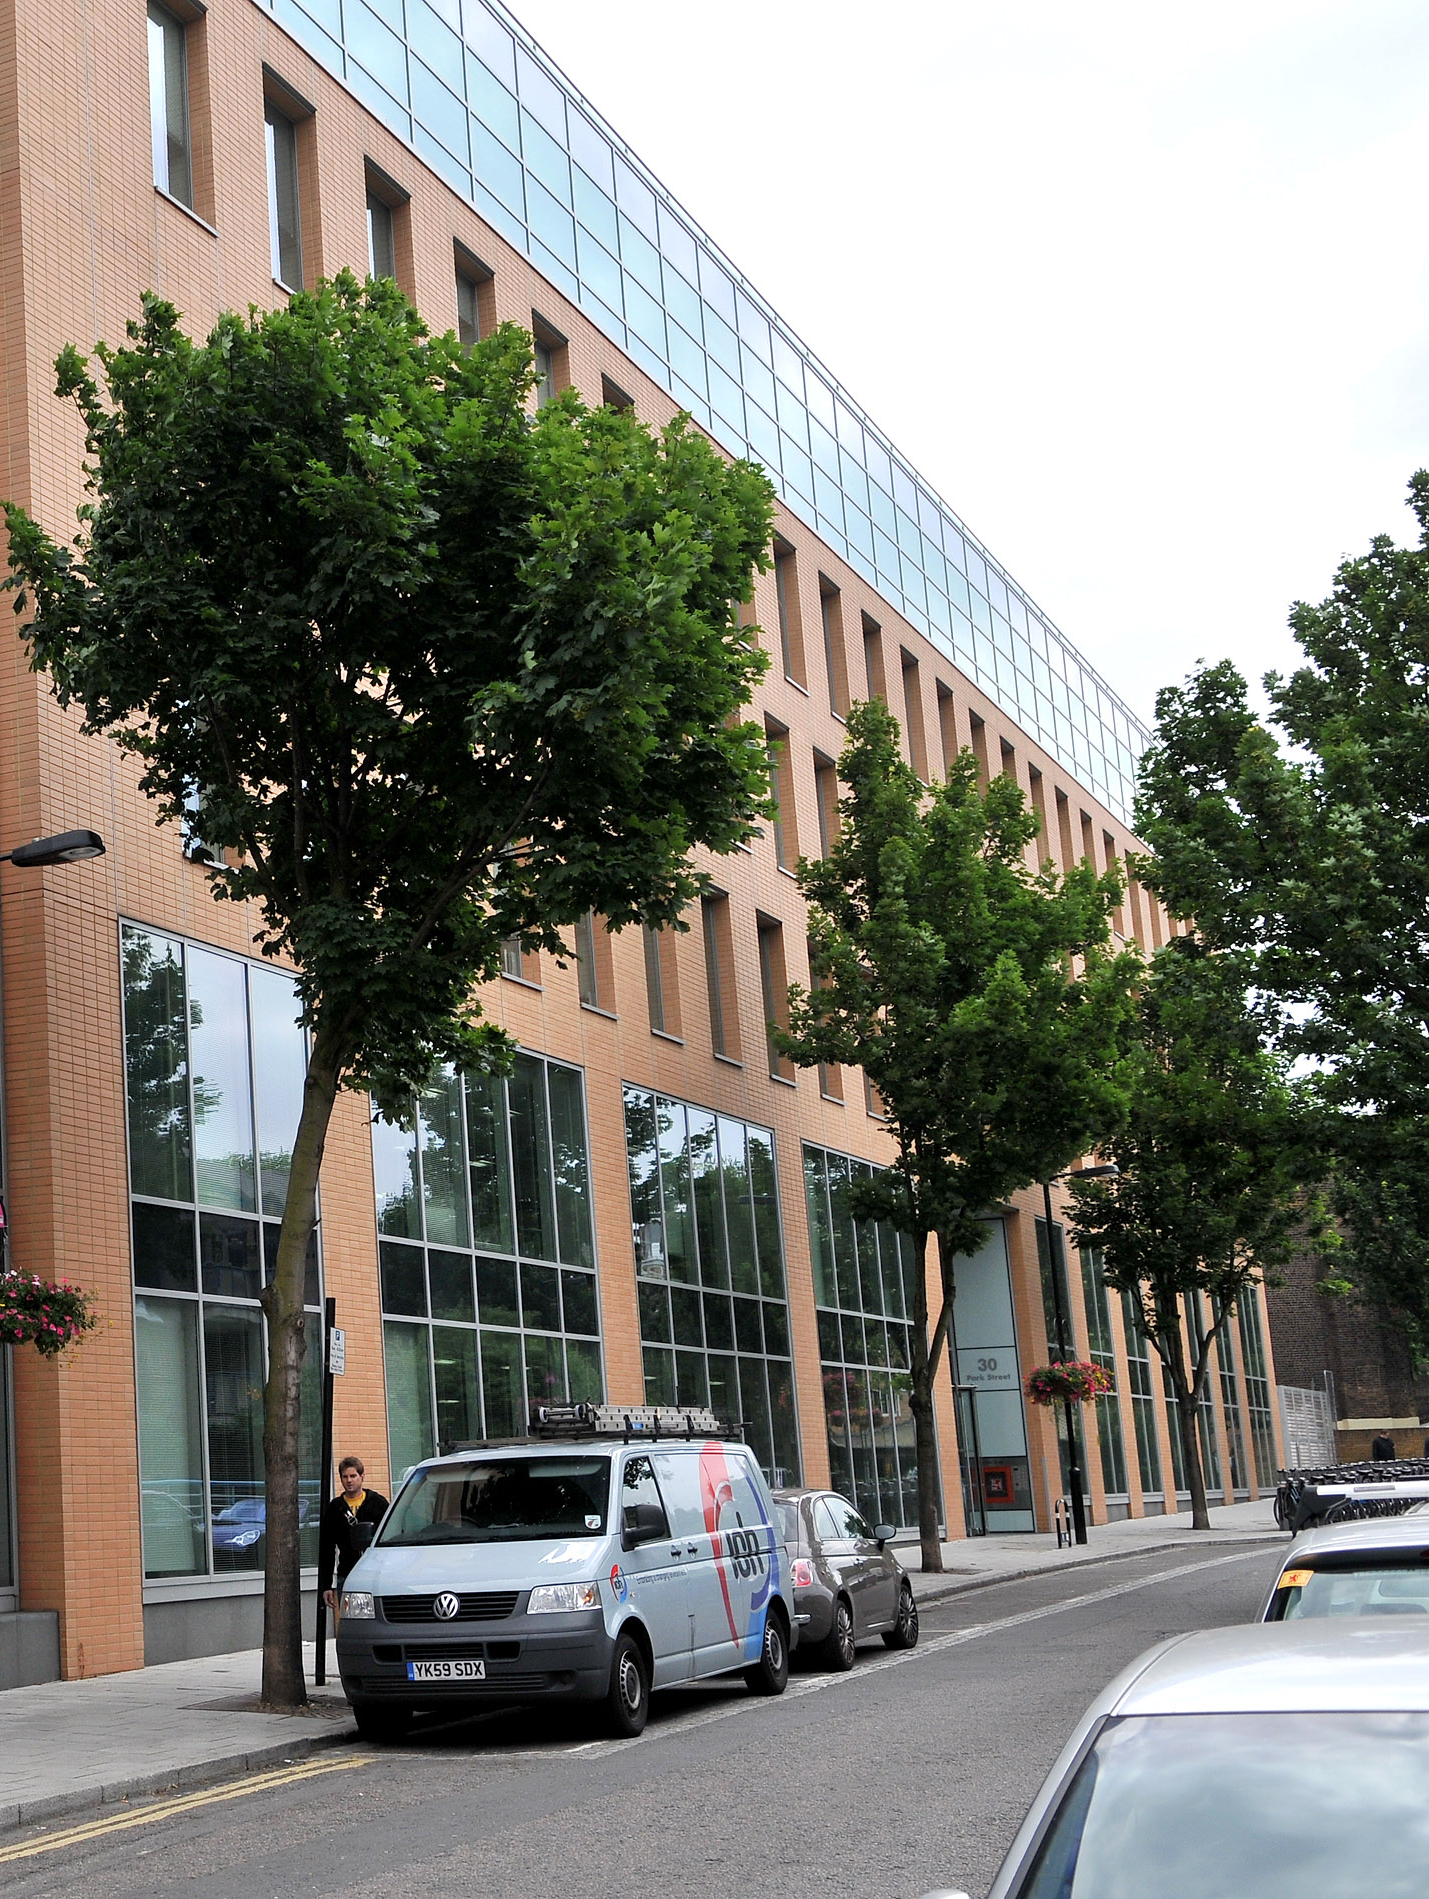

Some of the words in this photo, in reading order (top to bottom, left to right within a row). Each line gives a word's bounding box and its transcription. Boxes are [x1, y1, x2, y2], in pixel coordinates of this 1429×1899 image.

[977, 1358, 998, 1372] 30
[966, 1374, 986, 1382] Park
[987, 1373, 1012, 1381] Street
[414, 1663, 452, 1678] YK59
[454, 1662, 484, 1677] SDX
